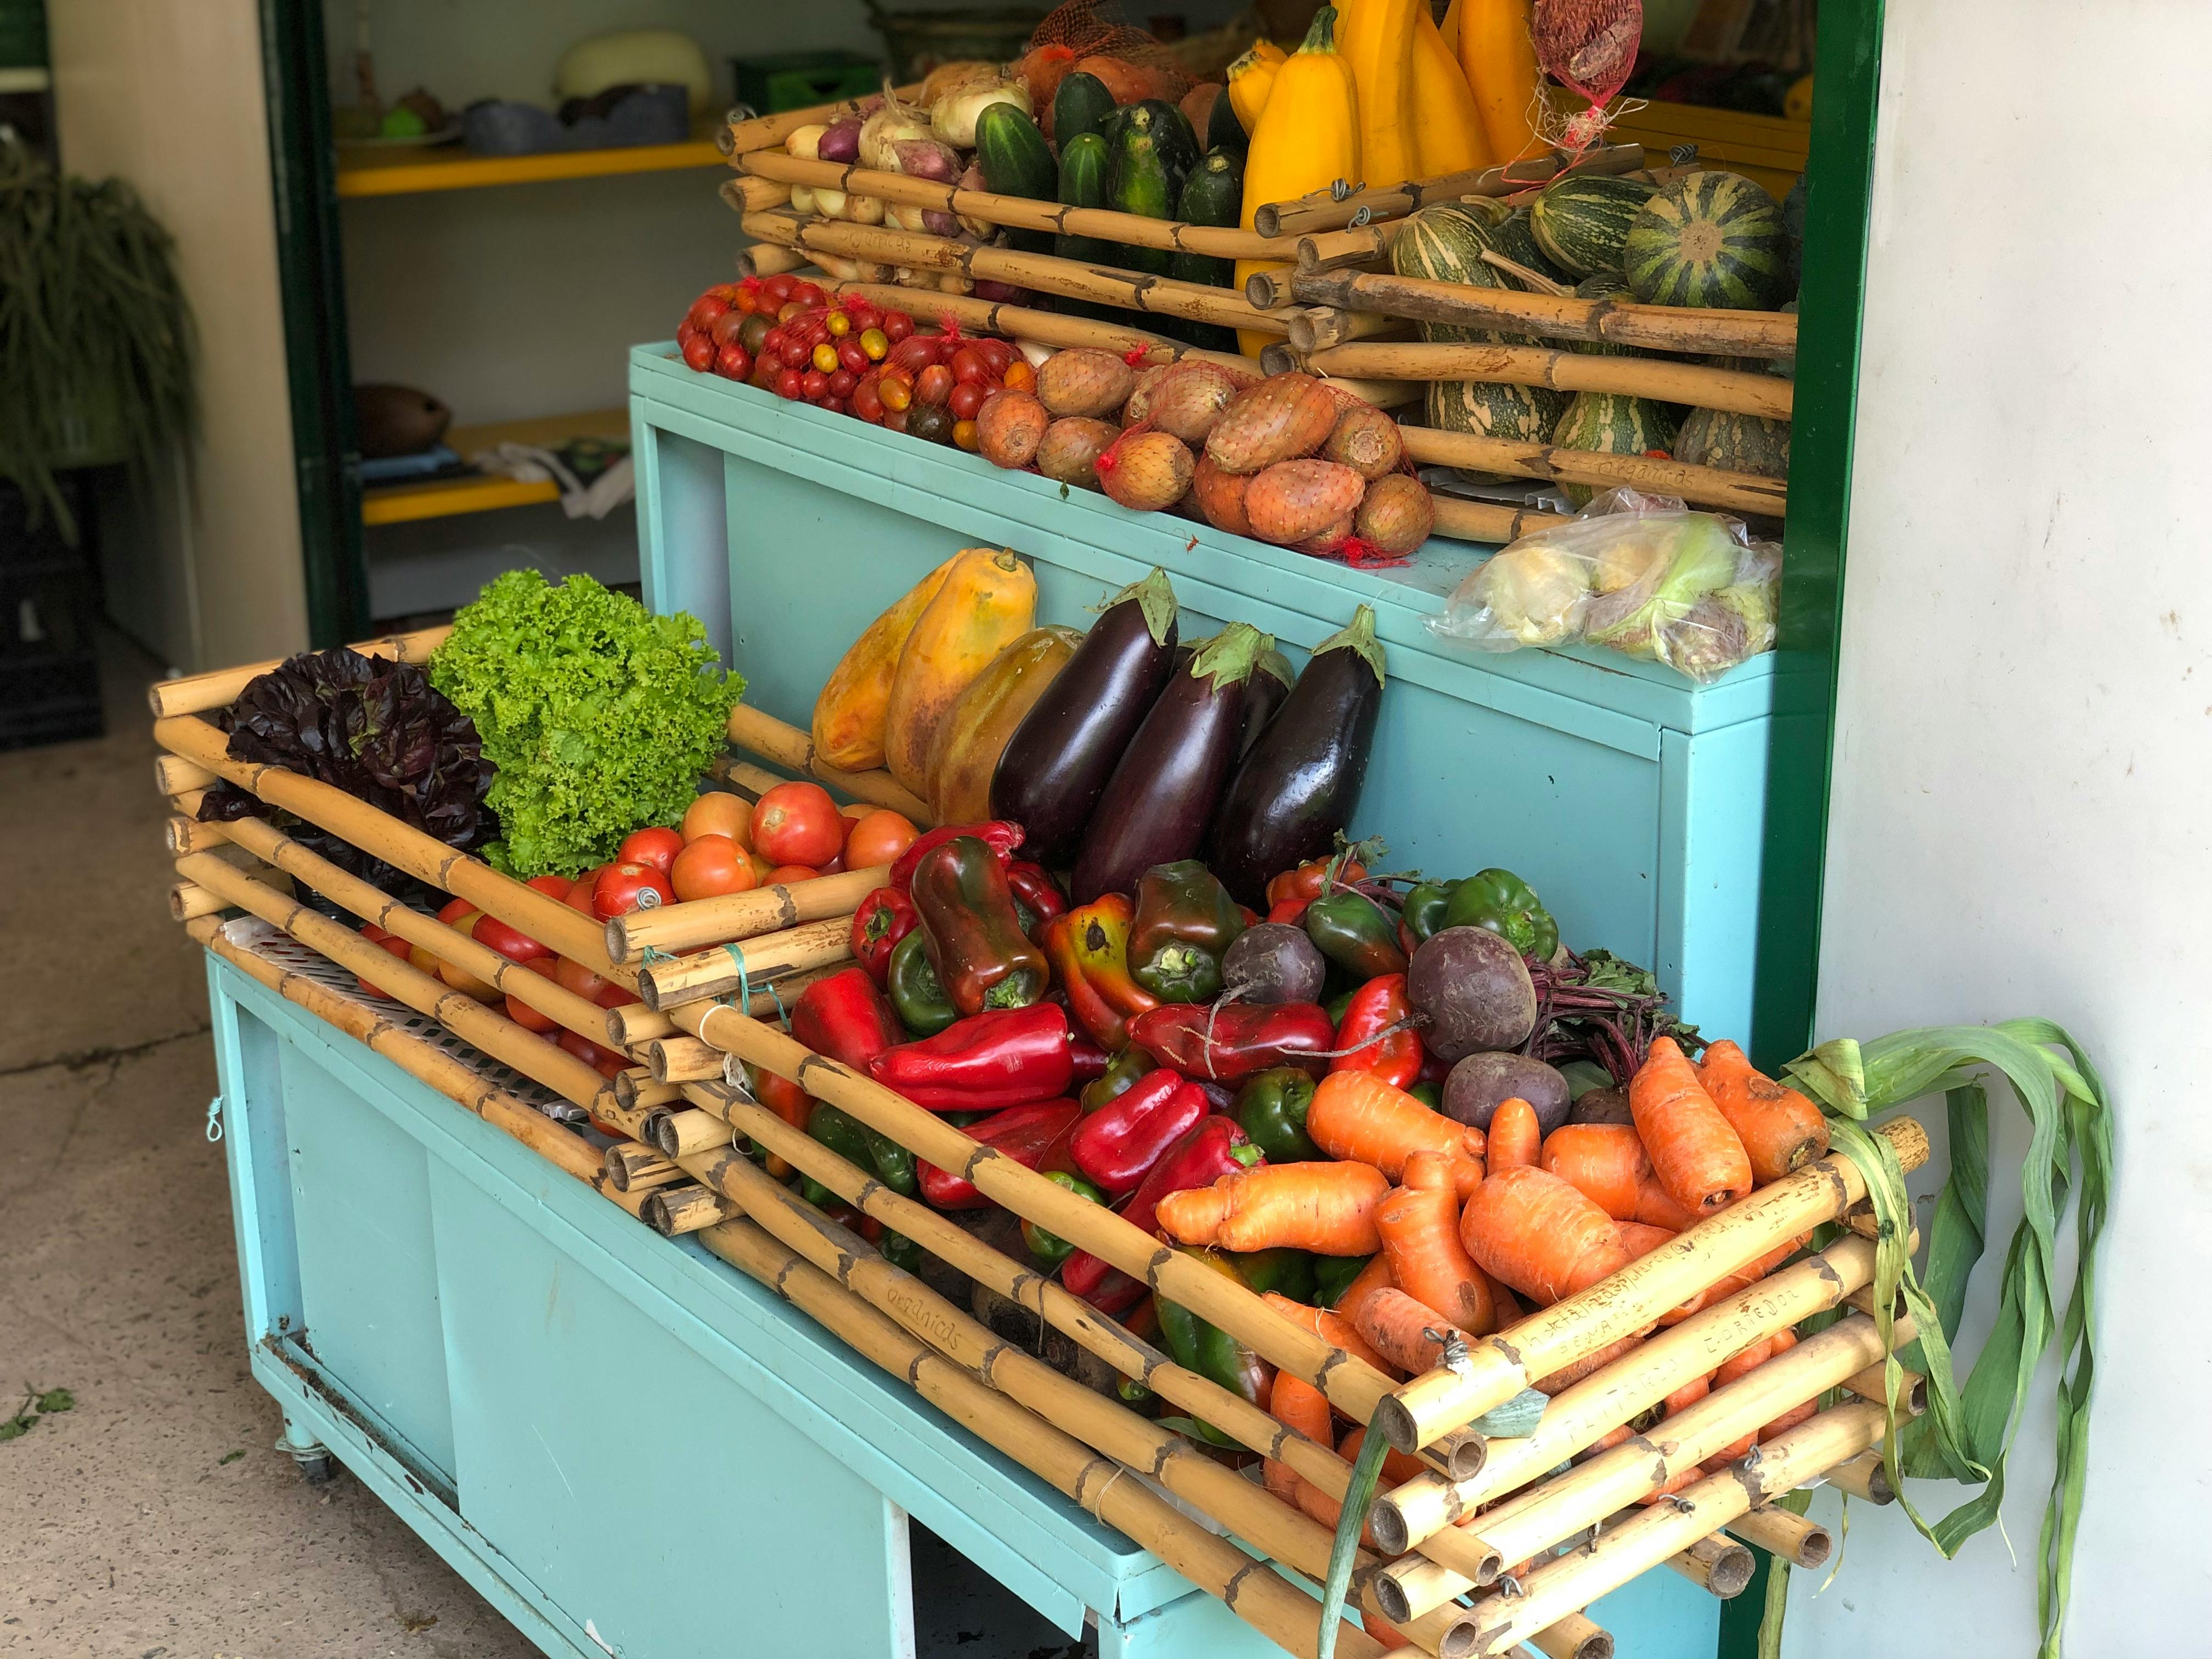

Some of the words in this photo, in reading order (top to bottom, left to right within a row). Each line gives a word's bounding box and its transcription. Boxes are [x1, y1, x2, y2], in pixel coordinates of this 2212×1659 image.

[1598, 461, 1695, 488] Organicas
[1559, 1320, 1612, 1354] SENA
[1704, 1290, 1799, 1354] CORREDOR
